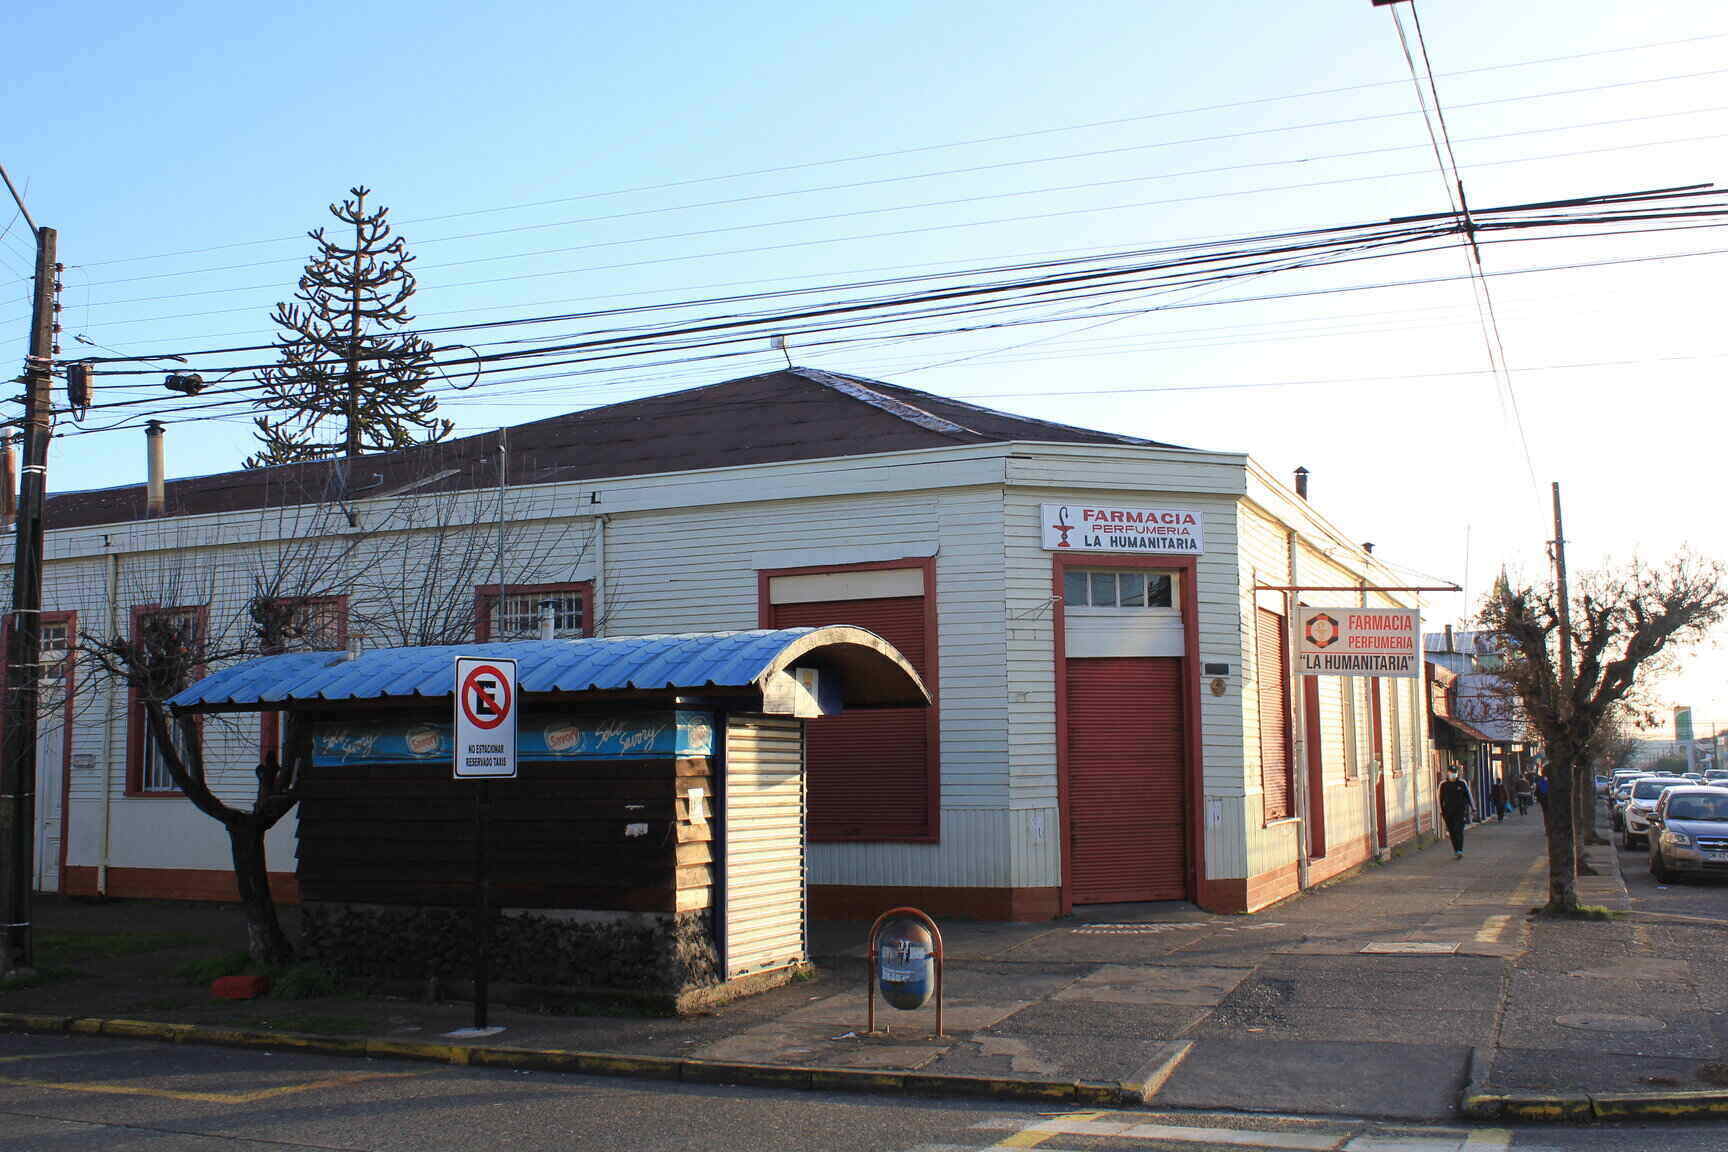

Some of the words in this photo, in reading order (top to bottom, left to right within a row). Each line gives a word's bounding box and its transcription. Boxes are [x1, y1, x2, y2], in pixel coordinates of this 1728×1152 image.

[1083, 509, 1196, 525] FARMACIA
[1092, 524, 1190, 535] PERFUMERIA
[1084, 535, 1101, 547] LA
[1110, 536, 1198, 549] HUMANITARIA
[1348, 615, 1412, 631] FARMACIA
[1348, 635, 1412, 649] PERFUMERIA
